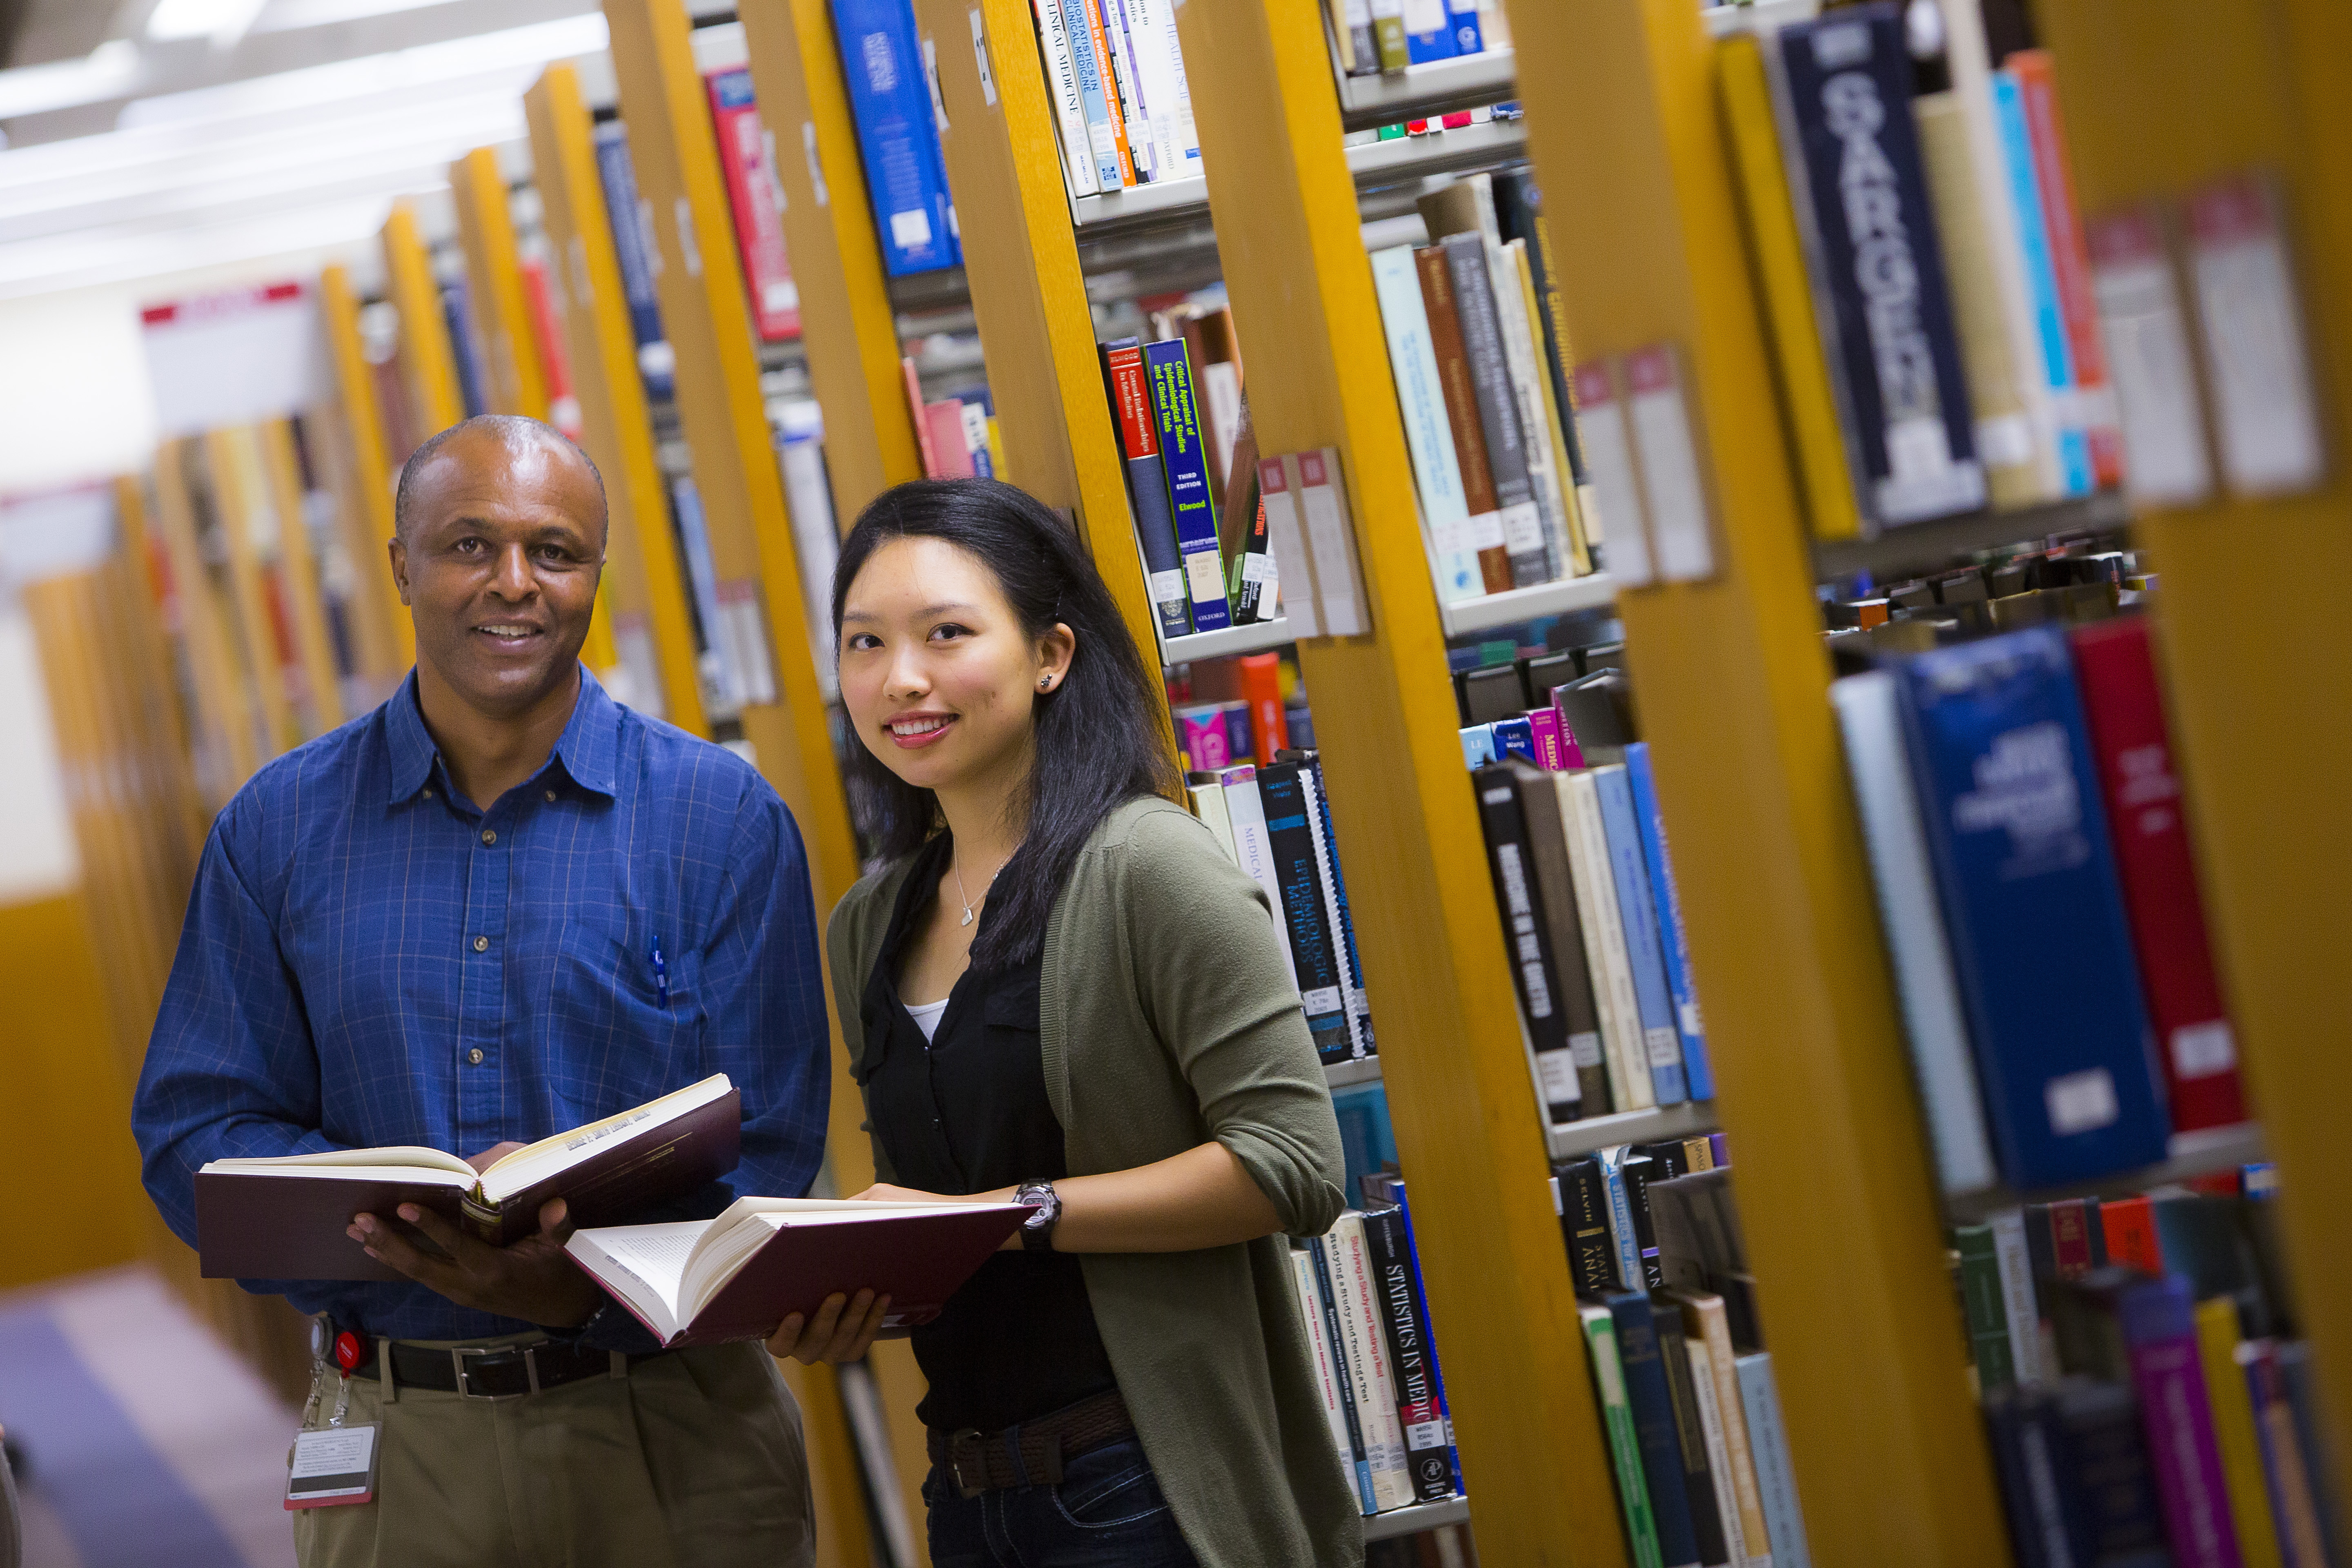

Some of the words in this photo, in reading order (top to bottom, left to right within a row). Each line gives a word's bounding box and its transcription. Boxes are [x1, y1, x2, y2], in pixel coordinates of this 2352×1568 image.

[1143, 17, 1149, 25] to
[1164, 9, 1172, 20] the
[1065, 0, 1080, 43] CLINICAL
[1075, 46, 1091, 93] MEDICINE
[1093, 29, 1101, 38] in
[1167, 24, 1183, 71] HEALTH
[1095, 39, 1115, 100] evidence-based
[1121, 55, 1129, 71] Read
[1127, 85, 1136, 107] Health
[1058, 54, 1079, 114] MEDICINE
[1091, 80, 1098, 90] IN
[1108, 102, 1122, 138] medicine
[1080, 155, 1089, 184] MACMILLAN
[1119, 151, 1129, 178] OXFORD
[1119, 372, 1126, 381] in
[1129, 370, 1140, 397] Causal
[1154, 365, 1163, 380] and
[1175, 361, 1187, 388] Critical
[1121, 381, 1133, 419] Medicine
[1157, 381, 1169, 410] Clinical
[1165, 363, 1182, 422] Epidemiological
[1175, 425, 1186, 454] Studies
[1179, 389, 1194, 425] Appraisal
[1134, 397, 1149, 453] Relationships
[1163, 411, 1173, 433] Trials
[1187, 427, 1195, 436] of
[1176, 481, 1201, 490] EDITION
[1178, 472, 1197, 481] THIRD
[1179, 500, 1205, 511] Elwood
[1198, 612, 1225, 622] OXFORD
[1287, 886, 1313, 963] METHODS
[1294, 859, 1330, 985] EPIDEMIOLOGIC
[612, 1118, 633, 1132] LIBRARY,
[1330, 1233, 1343, 1279] Studying
[1350, 1236, 1363, 1274] Studying
[1340, 1288, 1351, 1317] Study
[1359, 1281, 1370, 1306] Study
[1386, 1265, 1417, 1348] STATISTICS
[1327, 1308, 1339, 1340] Systematic
[1348, 1319, 1356, 1336] and
[1364, 1307, 1374, 1323] and
[1317, 1342, 1323, 1351] on
[1334, 1341, 1343, 1363] reviews
[1368, 1323, 1378, 1355] Testing
[1319, 1352, 1328, 1377] Medical
[1351, 1338, 1363, 1376] Testing
[1375, 1360, 1384, 1378] Test
[1402, 1351, 1421, 1368] IN
[1340, 1370, 1350, 1389] health
[1360, 1382, 1369, 1404] Test
[1324, 1379, 1335, 1410] Statistics
[1344, 1389, 1352, 1402] care
[1407, 1373, 1431, 1420] MEDIC
